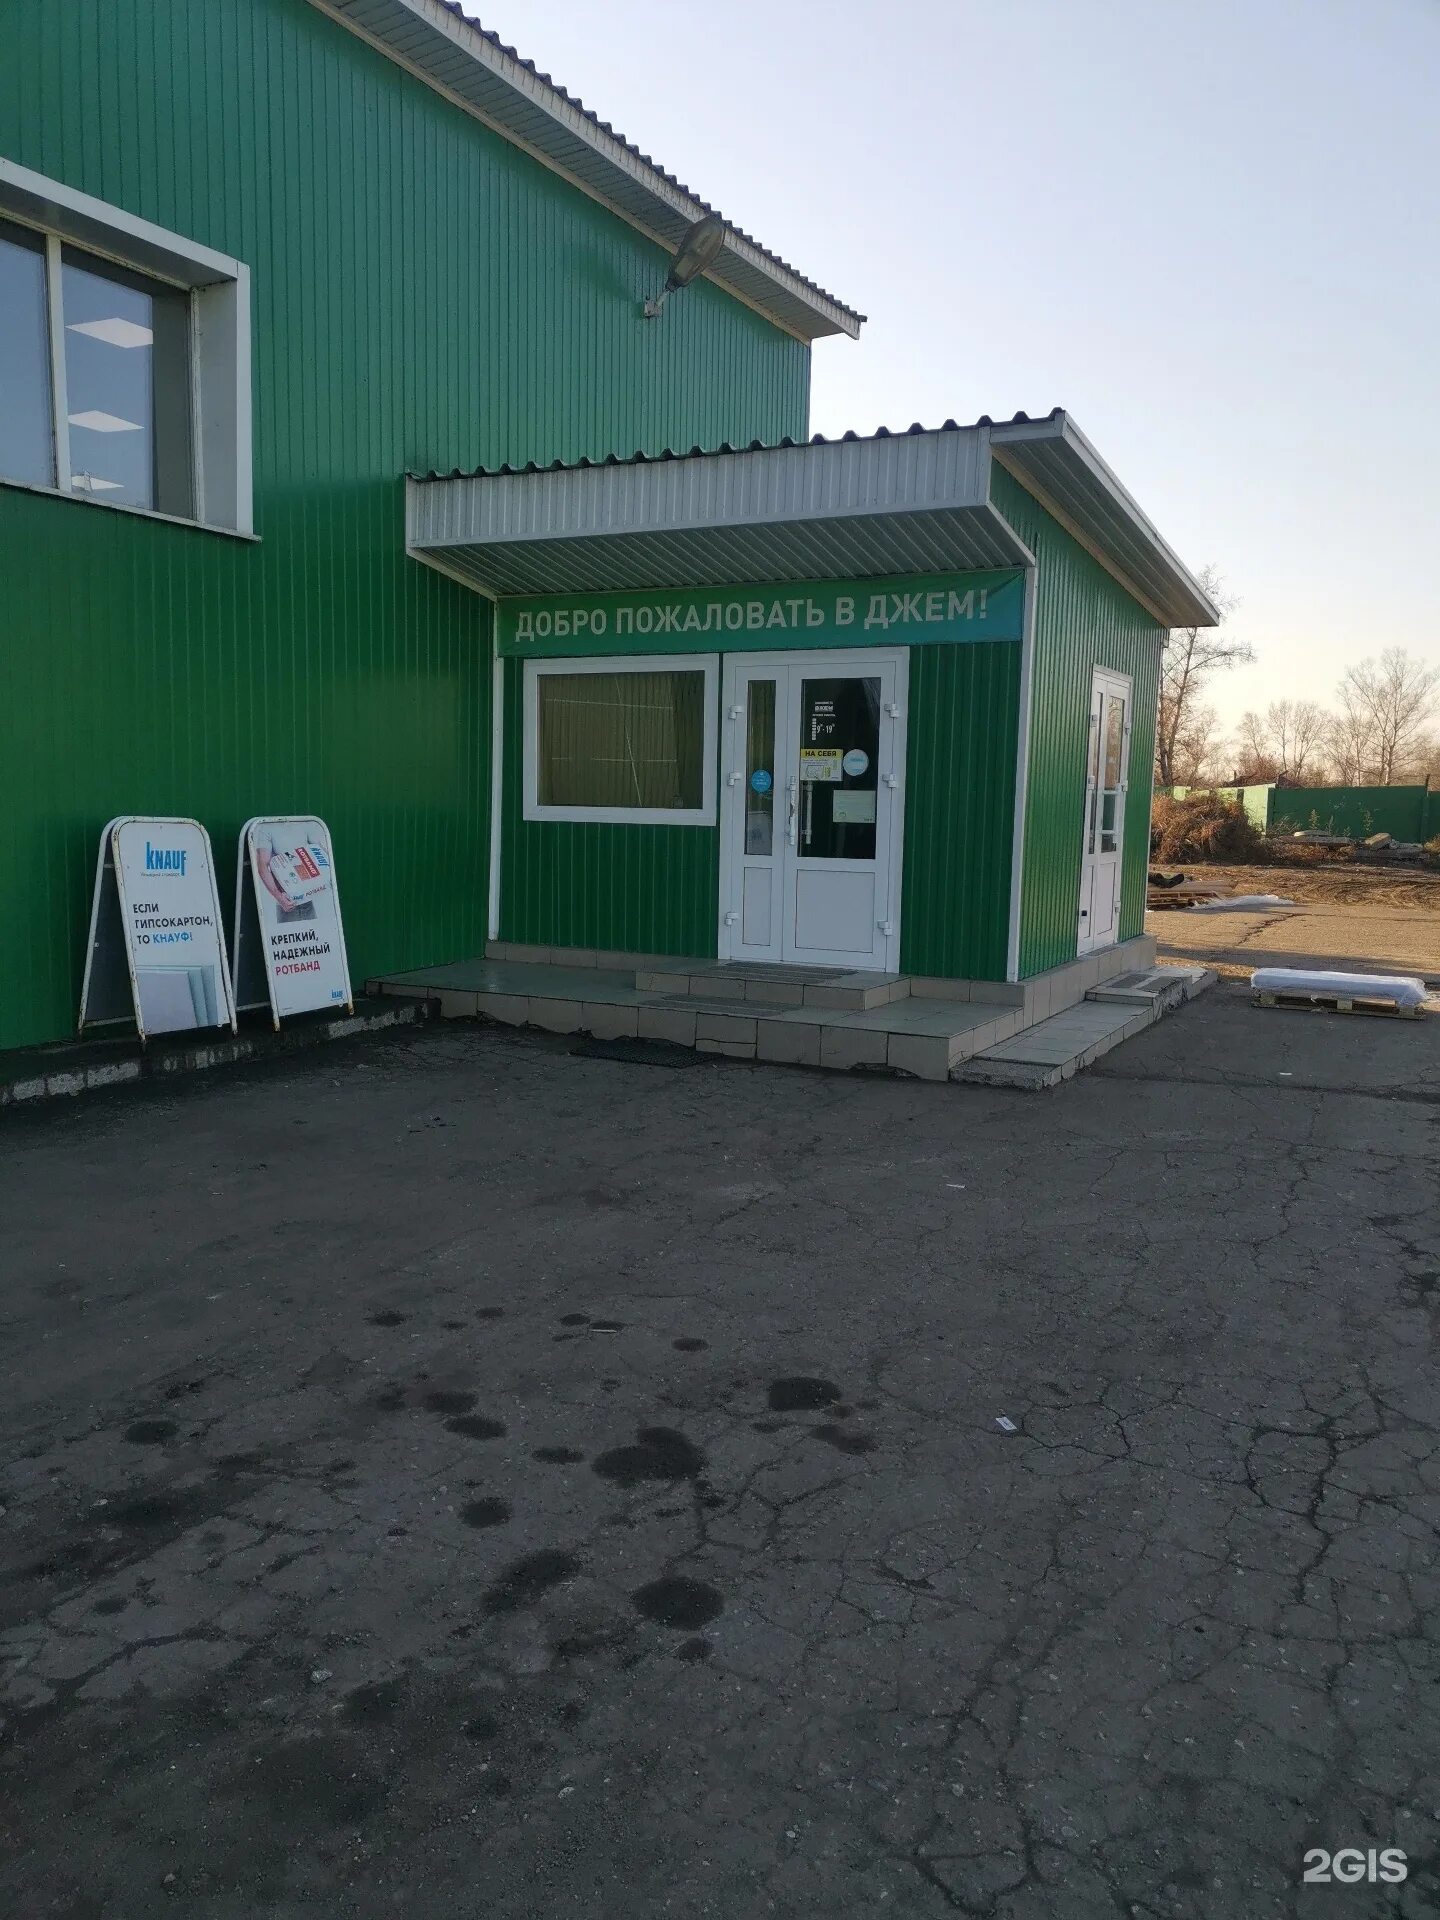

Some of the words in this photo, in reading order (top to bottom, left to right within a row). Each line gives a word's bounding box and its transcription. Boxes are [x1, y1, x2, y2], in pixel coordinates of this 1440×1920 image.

[515, 608, 607, 642] ДОБРО
[616, 599, 825, 634] ПОЖАЛОВАТЬ
[835, 597, 855, 626] В
[864, 589, 988, 630] ДЖЕМ!
[146, 841, 187, 876] KNAUF
[133, 903, 159, 914] ЕСЛИ
[135, 916, 213, 929] ГИПСОКАРТОН,
[137, 934, 150, 944] ТО
[152, 932, 193, 944] КНАУФ!
[271, 928, 319, 946] КРЕПКИЙ,
[273, 941, 331, 961] НАДЕЖНЫЙ
[275, 960, 321, 976] РОТБАНД
